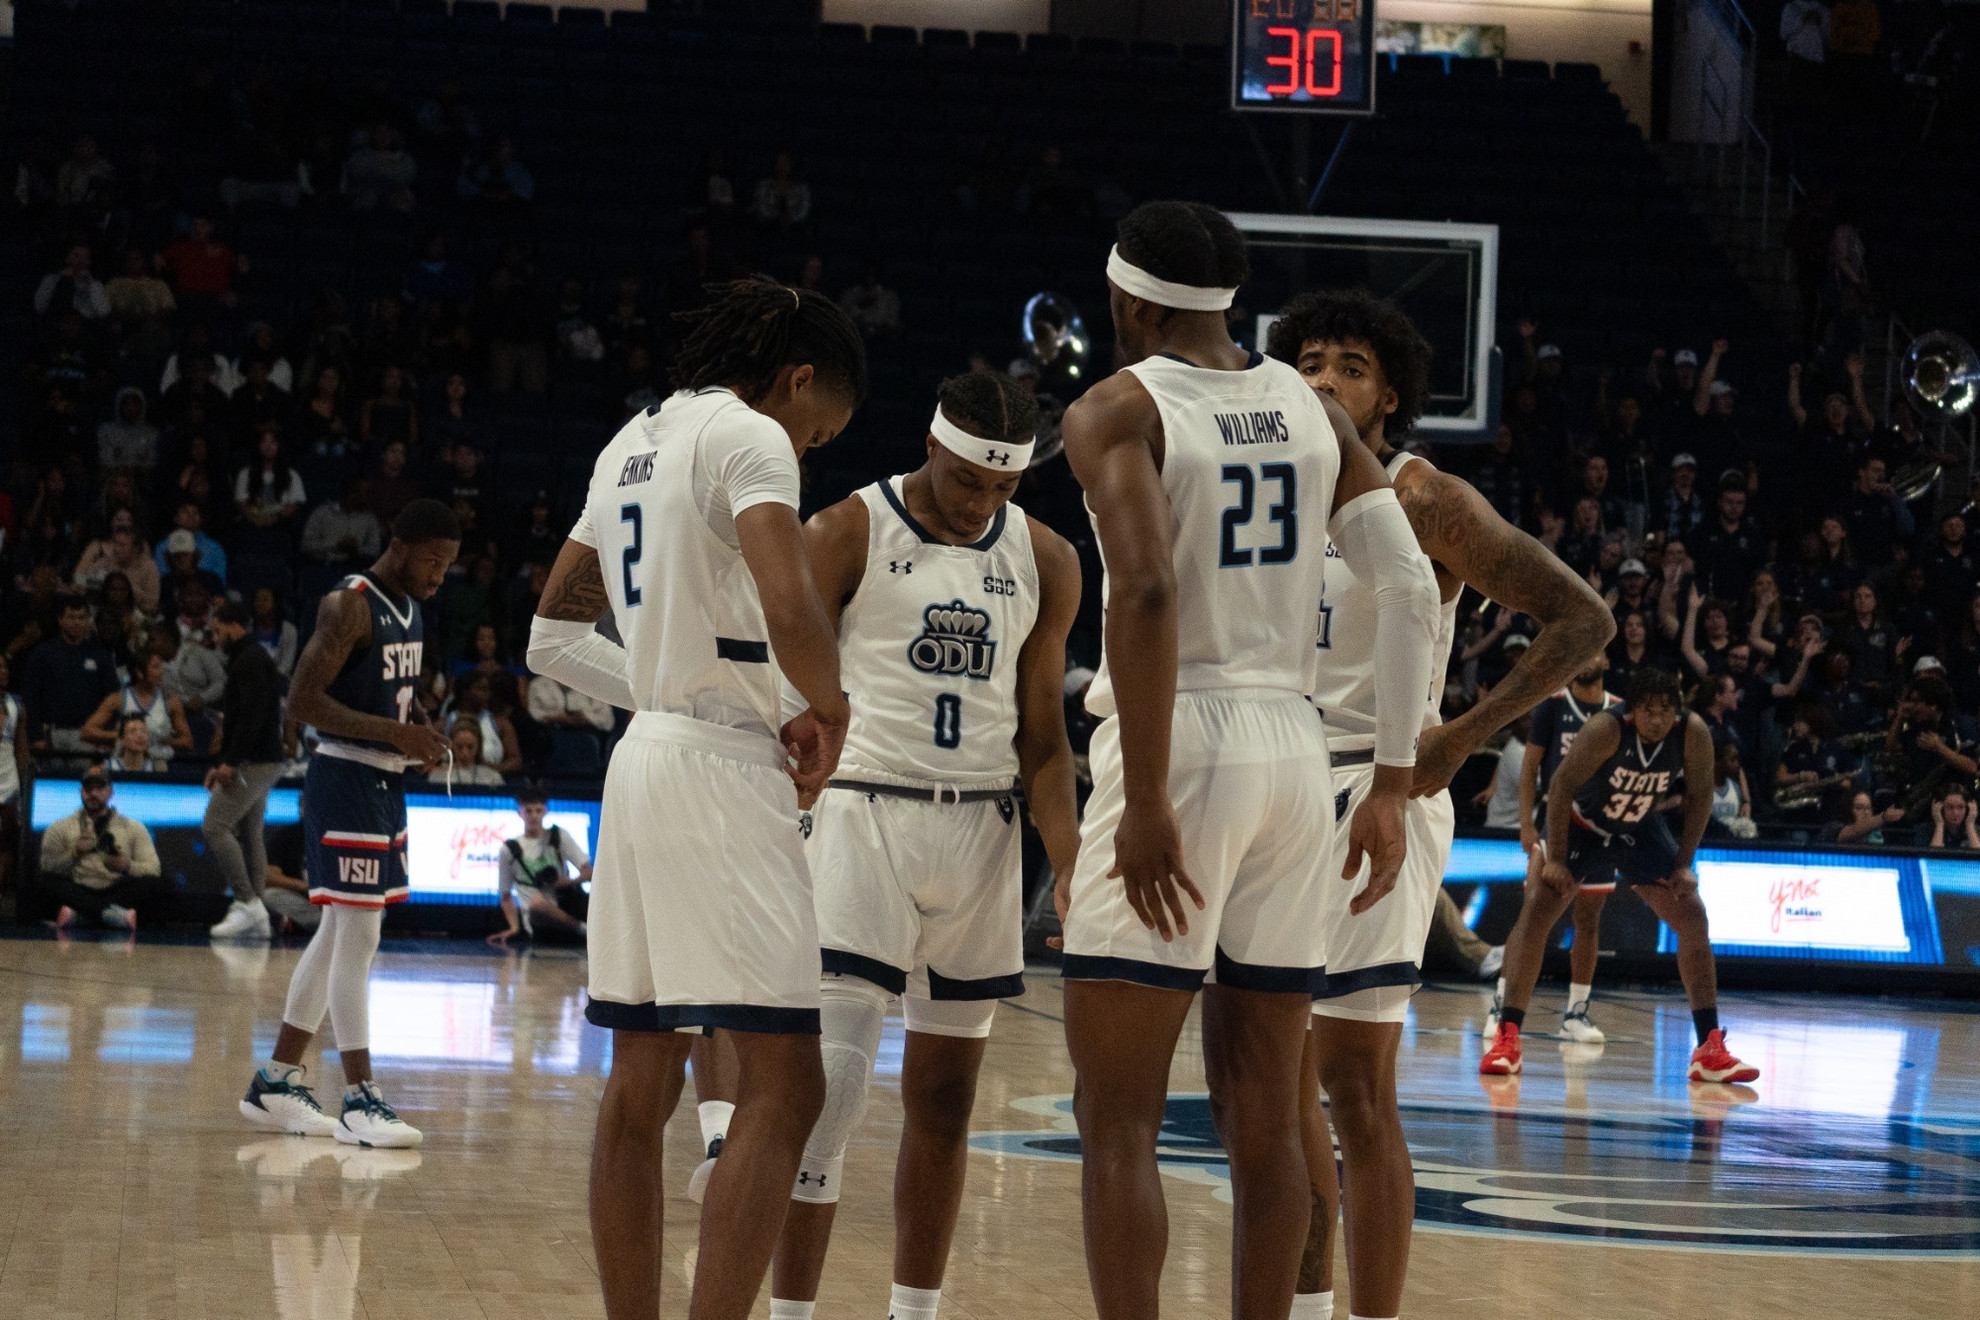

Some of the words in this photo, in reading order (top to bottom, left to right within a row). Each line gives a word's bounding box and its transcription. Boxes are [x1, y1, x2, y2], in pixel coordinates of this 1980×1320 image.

[1266, 27, 1342, 96] 30
[1214, 411, 1289, 445] WILLIAMS
[617, 450, 658, 487] JENKINS
[1219, 461, 1298, 569] 23
[621, 502, 642, 608] 2
[909, 634, 997, 681] ODU
[935, 692, 962, 749] 0
[1609, 766, 1670, 793] STATE
[1602, 793, 1654, 823] 33
[338, 856, 380, 885] VSU
